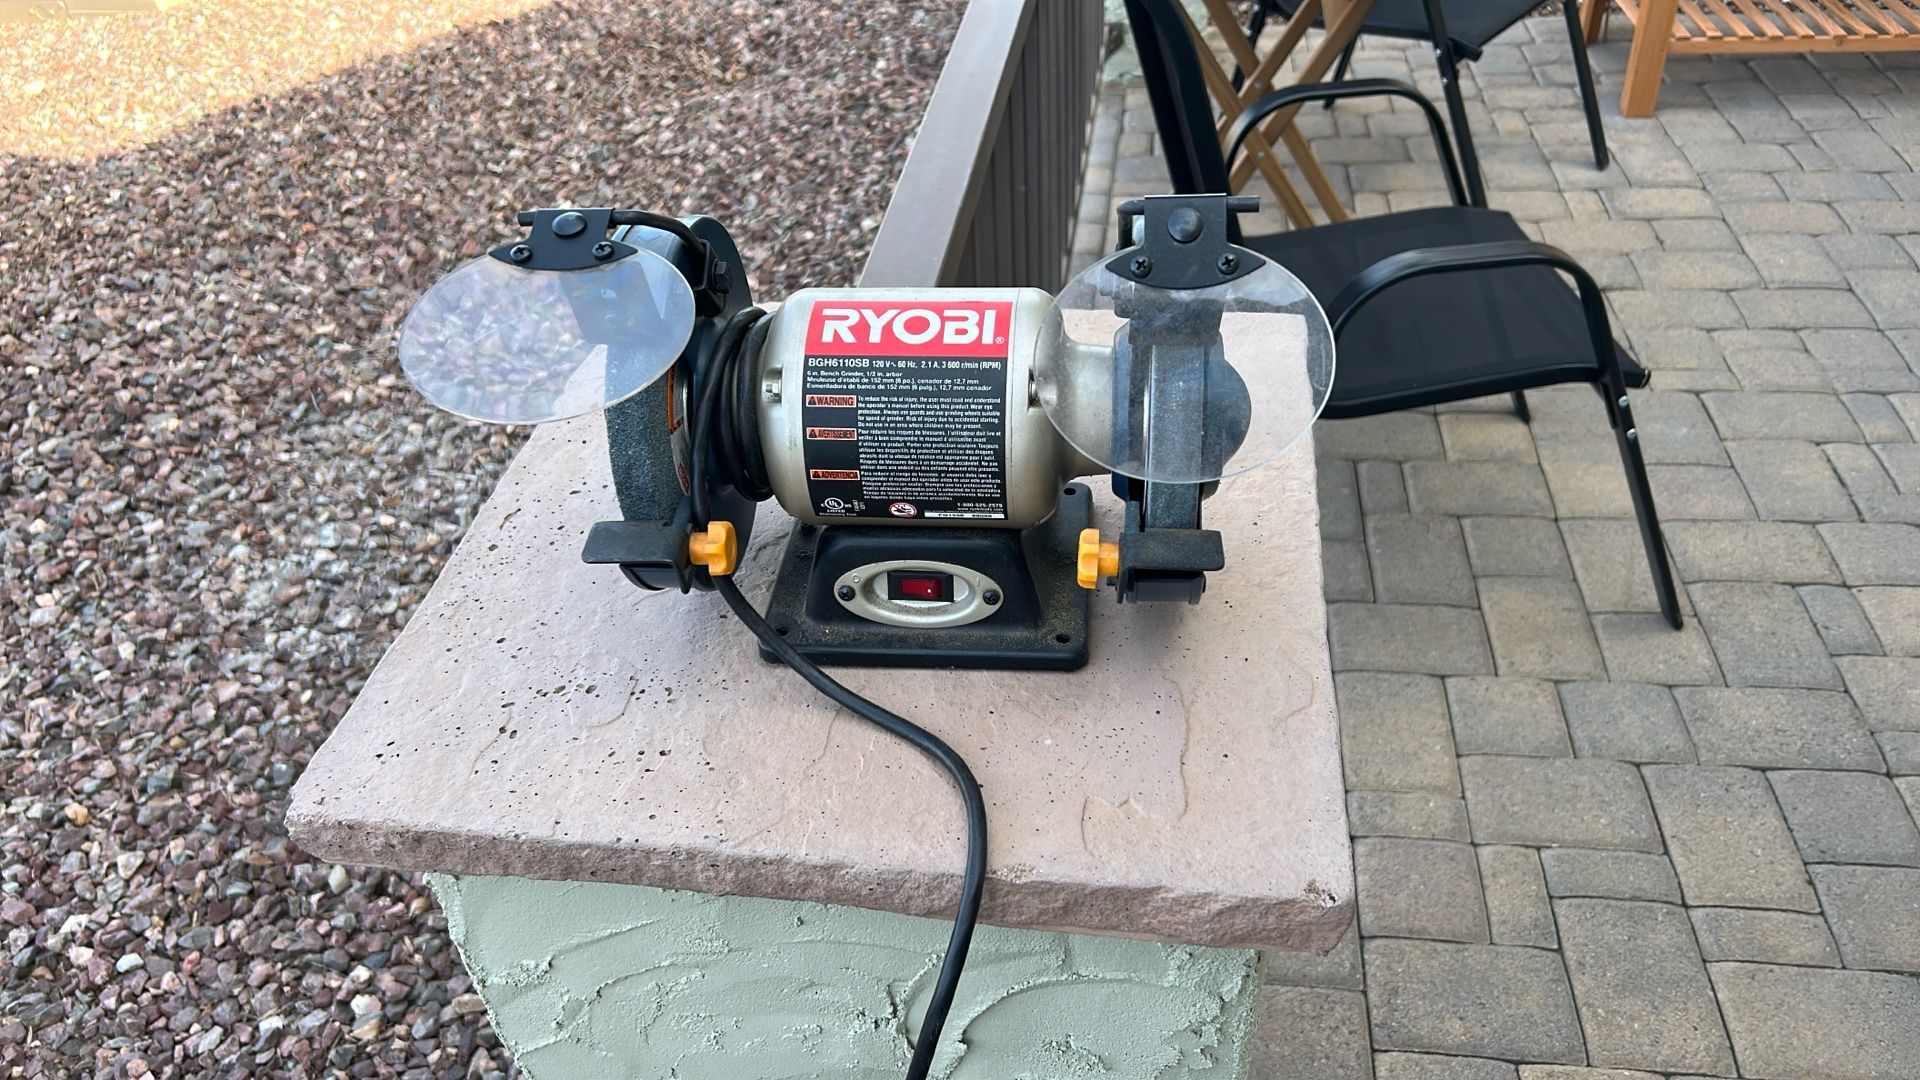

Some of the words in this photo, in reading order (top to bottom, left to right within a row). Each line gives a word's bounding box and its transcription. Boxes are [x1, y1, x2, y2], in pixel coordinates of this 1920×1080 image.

[821, 308, 996, 345] RYOBI
[808, 358, 870, 367] BGH6110SB
[872, 360, 884, 368] 120
[942, 361, 947, 369] 3
[947, 361, 960, 369] 600
[979, 362, 1001, 370] (RPM)
[817, 396, 854, 406] WARNING
